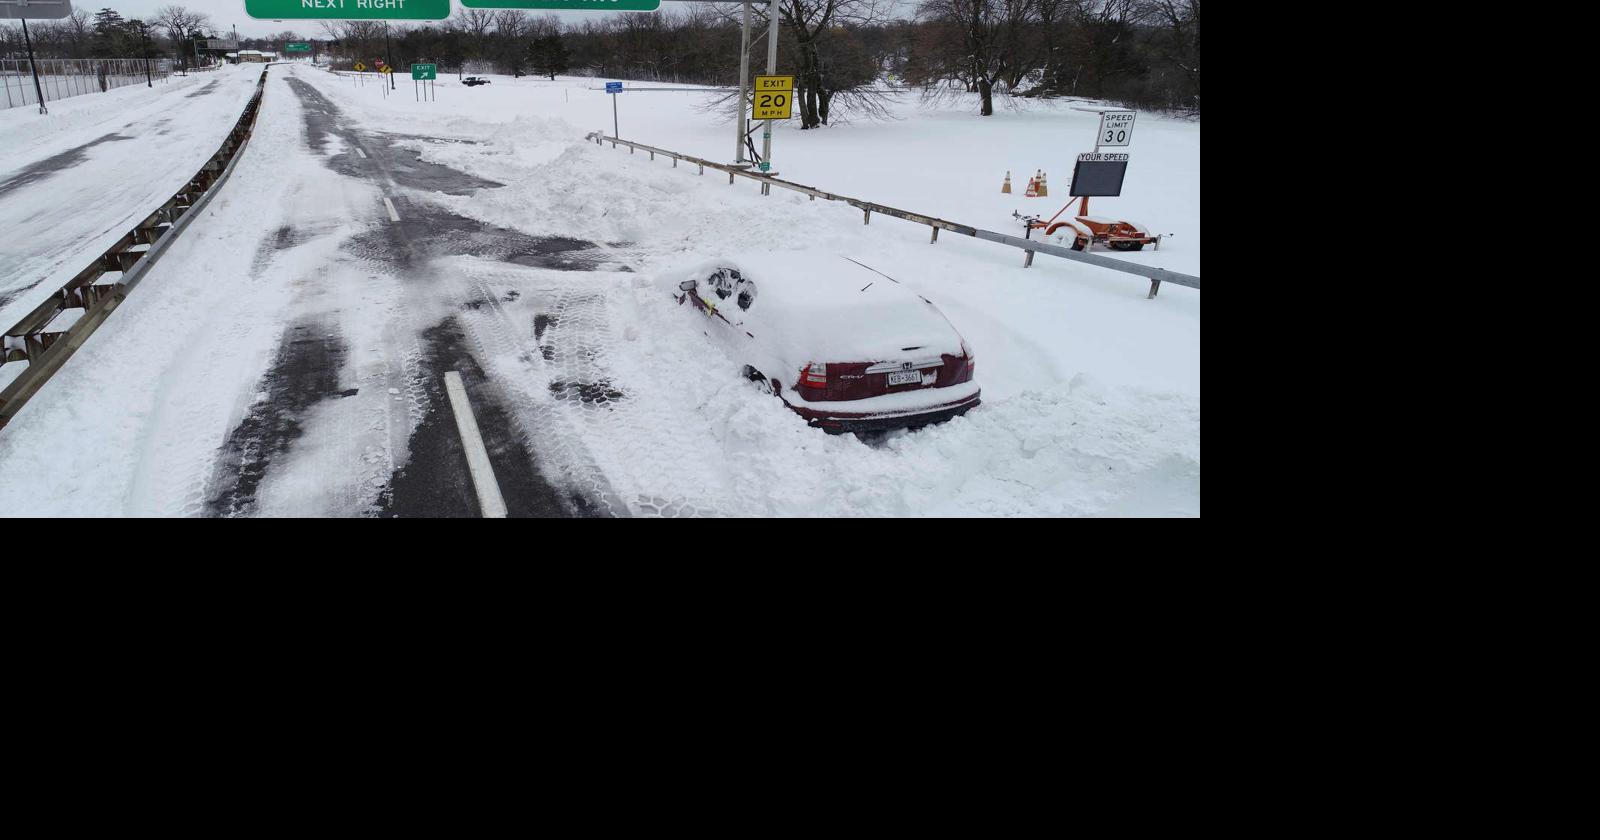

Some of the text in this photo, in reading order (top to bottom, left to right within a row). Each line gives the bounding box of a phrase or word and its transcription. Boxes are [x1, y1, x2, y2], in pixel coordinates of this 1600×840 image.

[302, 0, 406, 8] NEXT RIGHT
[763, 79, 786, 88] EXIT
[759, 94, 786, 108] 20
[1104, 130, 1126, 143] 30
[1080, 153, 1129, 161] YOUR SPEED
